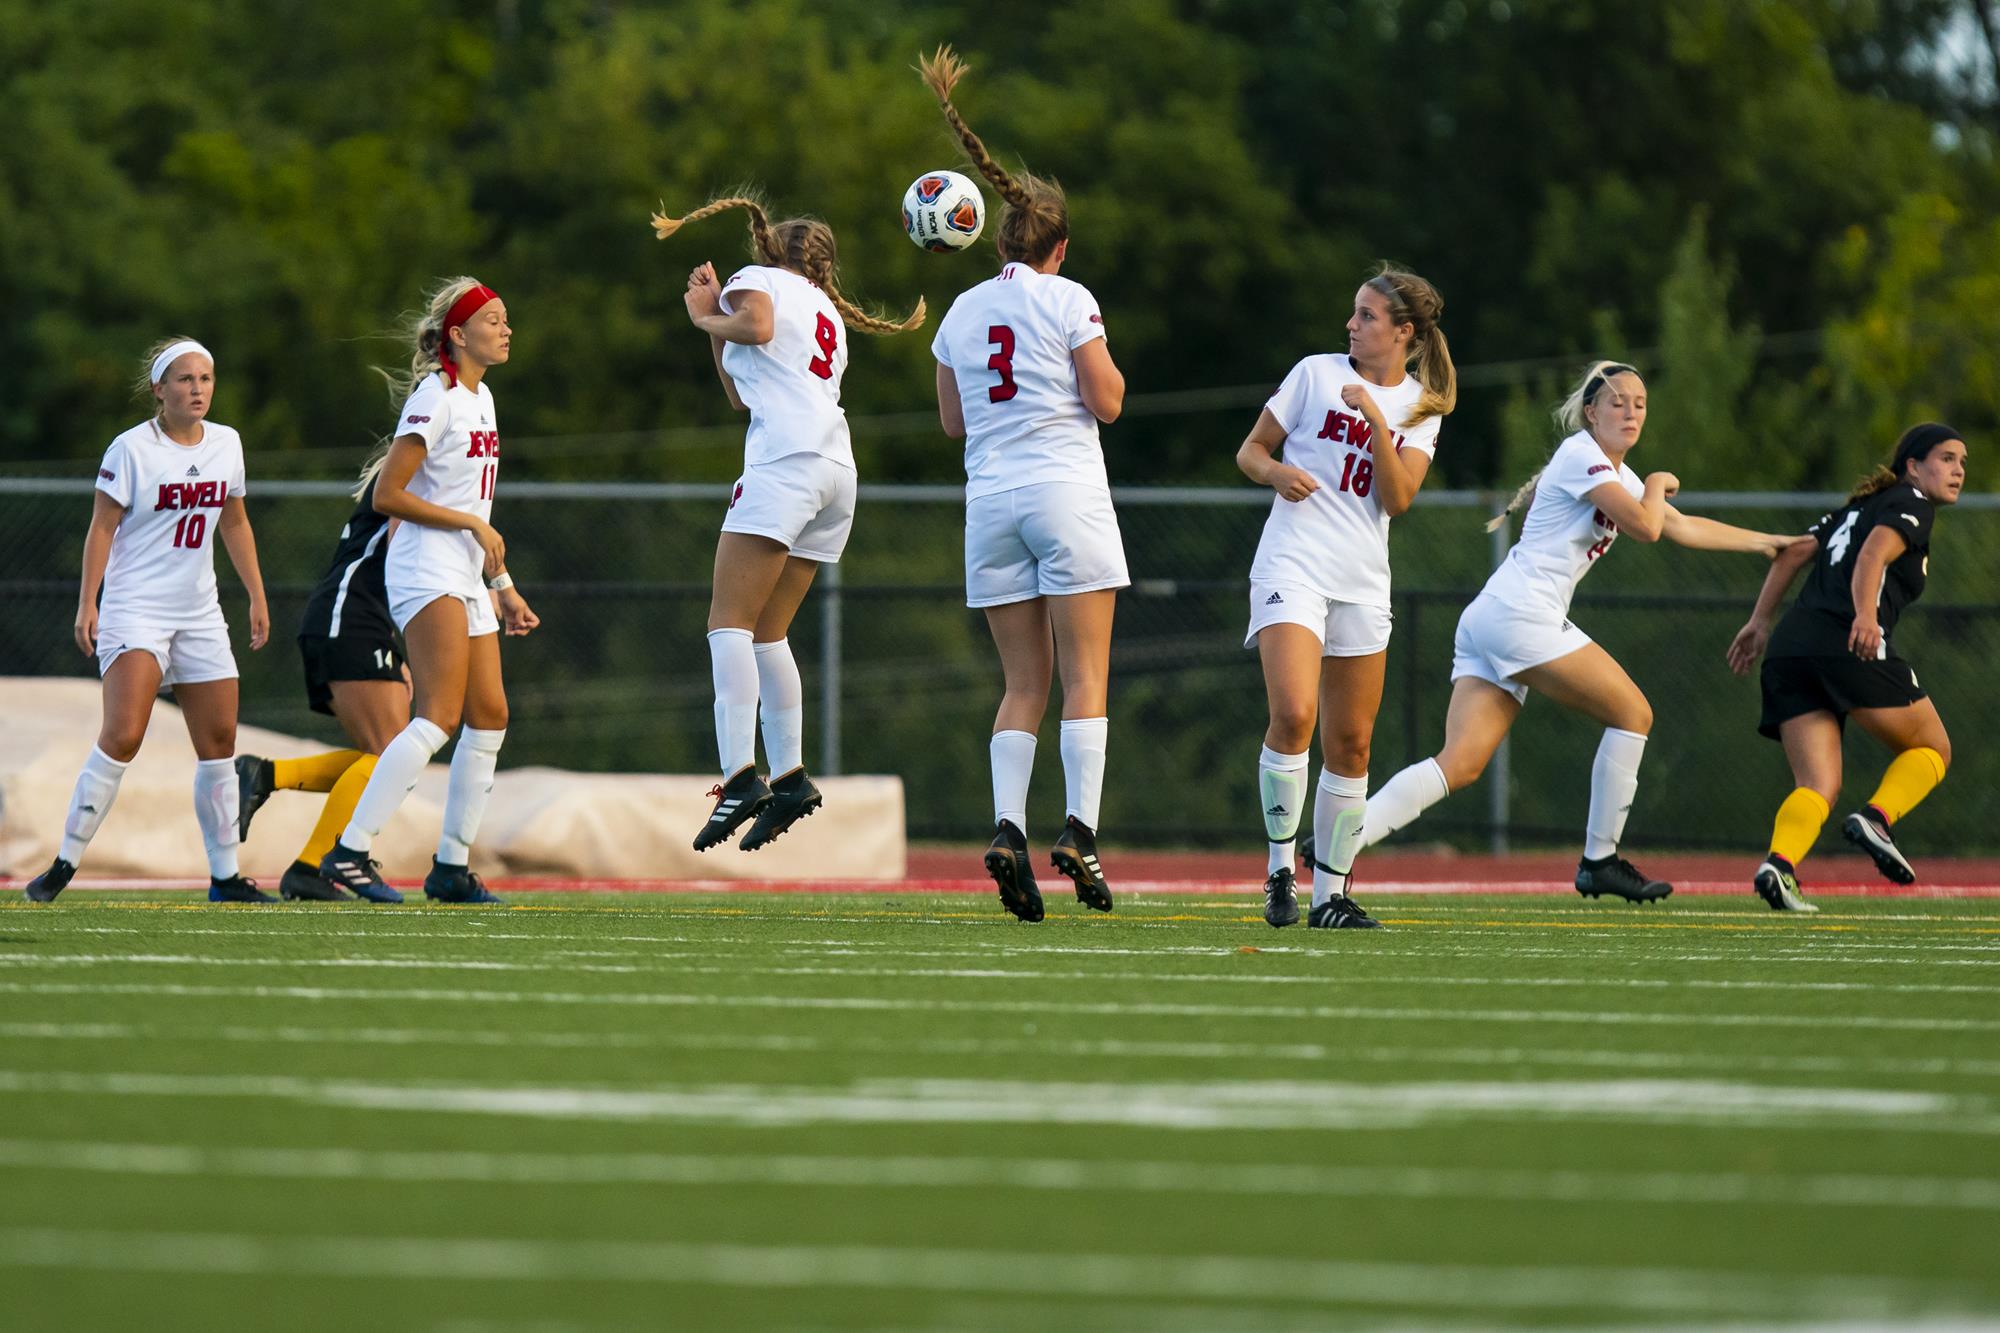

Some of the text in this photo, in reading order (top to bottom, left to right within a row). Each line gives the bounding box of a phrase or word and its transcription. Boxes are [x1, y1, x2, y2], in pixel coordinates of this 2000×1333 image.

[928, 211, 939, 235] NCAA
[809, 310, 838, 381] 9
[988, 325, 1018, 404] 3
[480, 463, 495, 500] 11
[1339, 452, 1373, 498] 18
[173, 514, 206, 549] 10
[1826, 511, 1860, 566] 4
[373, 648, 393, 670] 14
